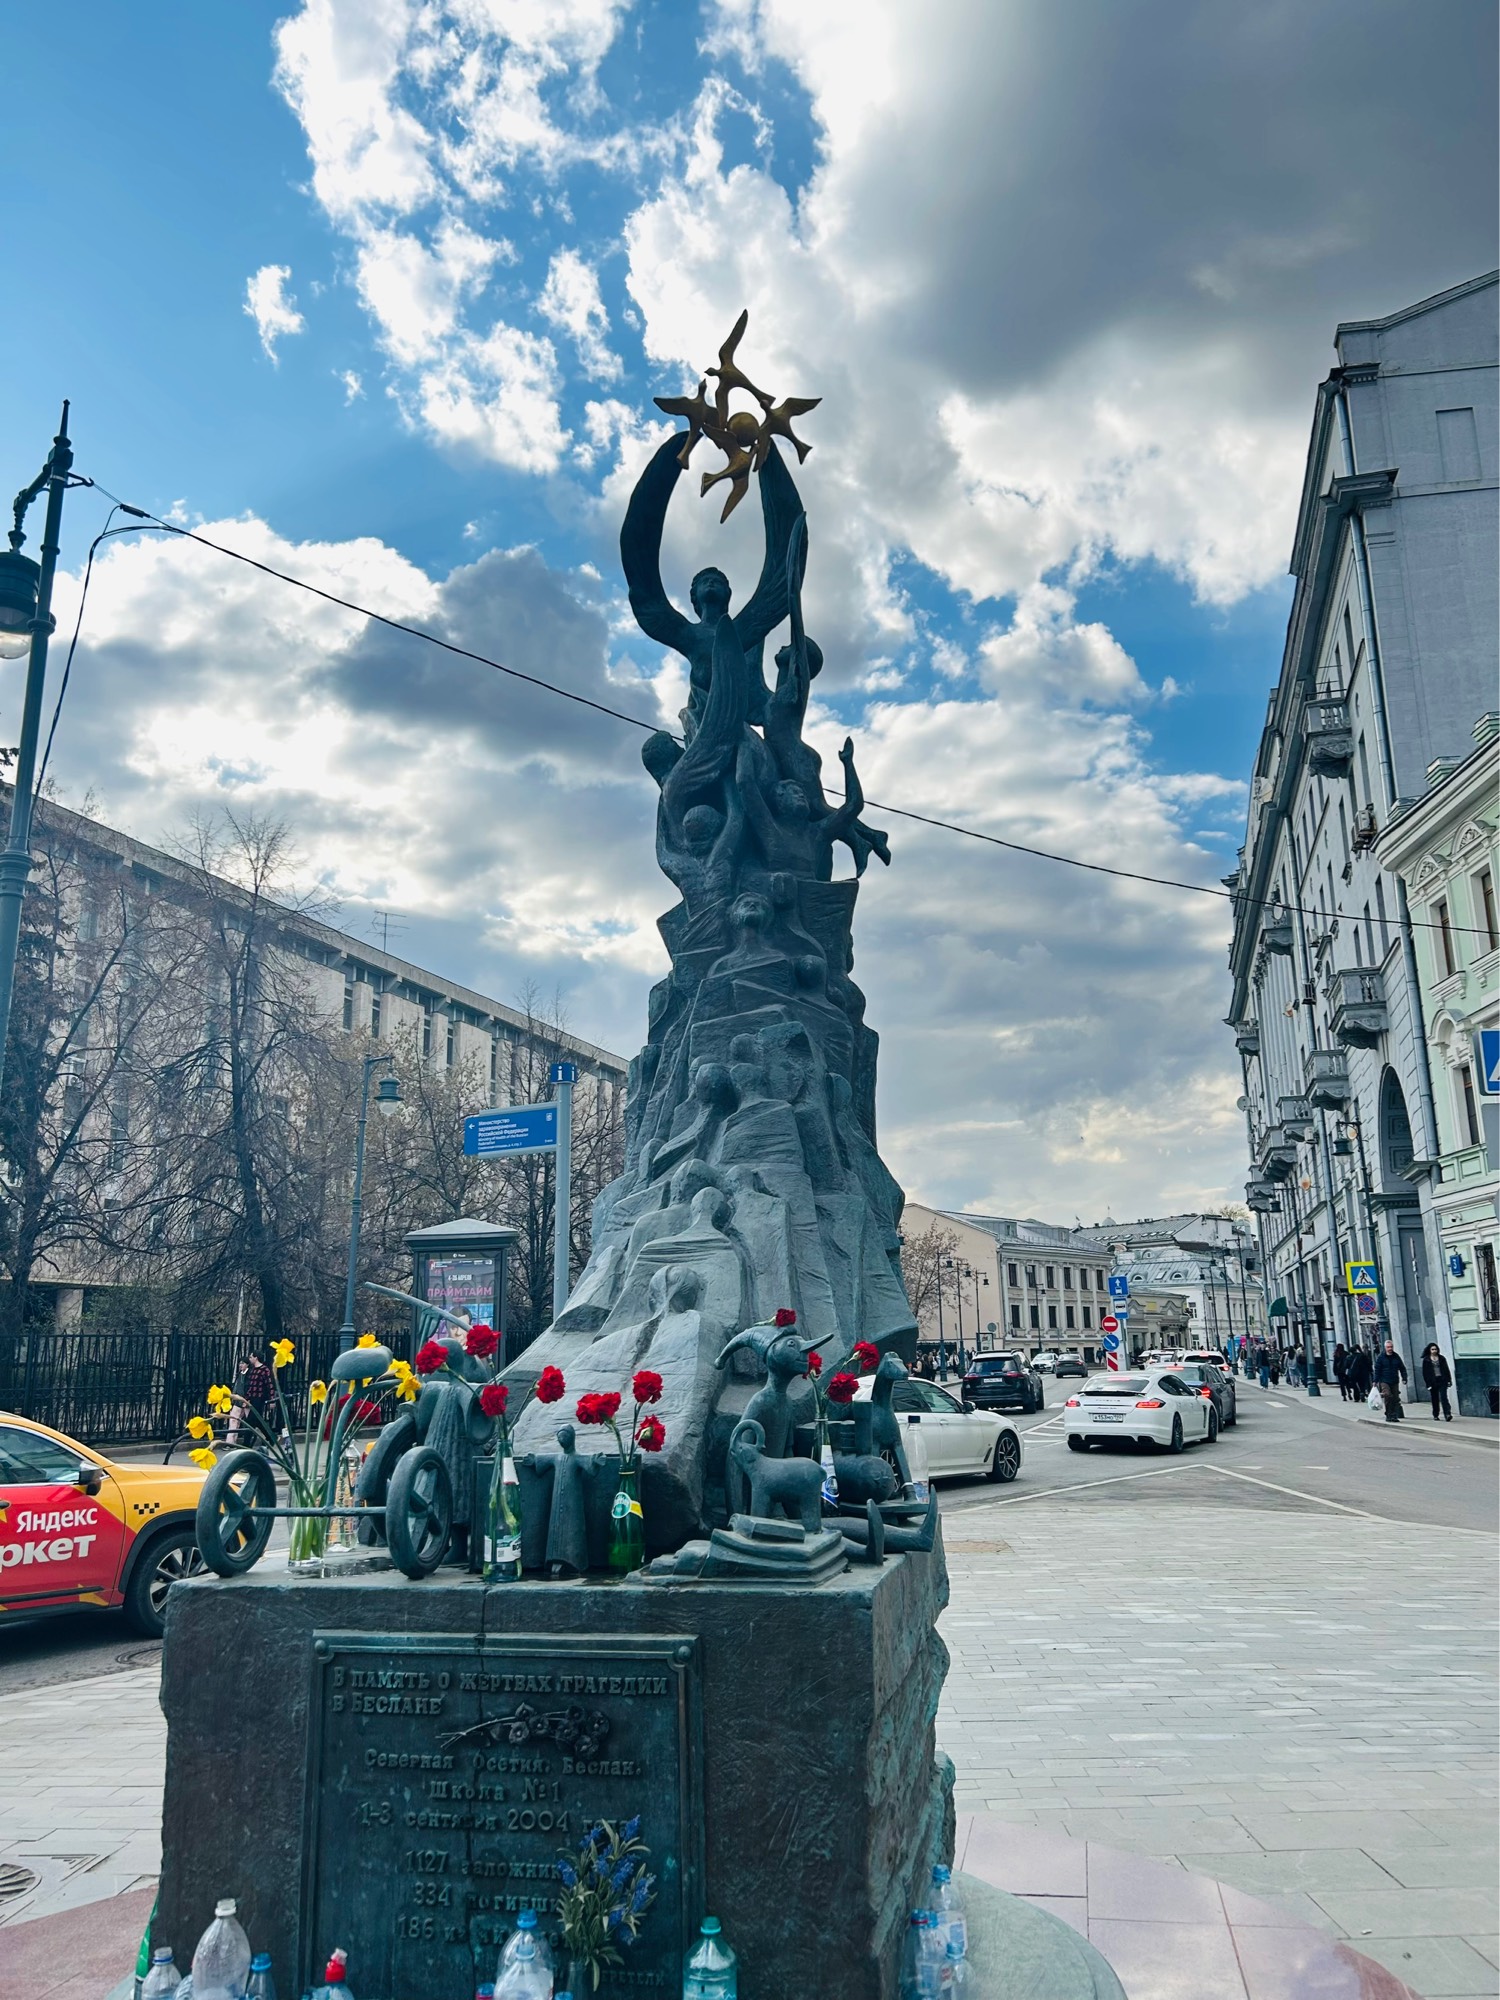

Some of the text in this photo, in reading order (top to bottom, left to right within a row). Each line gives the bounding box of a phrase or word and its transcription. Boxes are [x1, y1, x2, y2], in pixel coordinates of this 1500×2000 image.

[16, 1507, 98, 1533] Яндекс
[0, 1534, 97, 1574] ркет
[333, 1666, 668, 1696] В ПАМЯТЬ О ЖЕРТВАХ ТРАГЕДИИ
[364, 1748, 455, 1769] Северная
[430, 1781, 504, 1800] Школа
[507, 1808, 569, 1832] 2004
[405, 1850, 564, 1880] 1127 заложник
[413, 1881, 561, 1913] 334 погибши
[398, 1915, 435, 1940] 186
[600, 1968, 666, 1987] ЕРЕТЕЛИ
